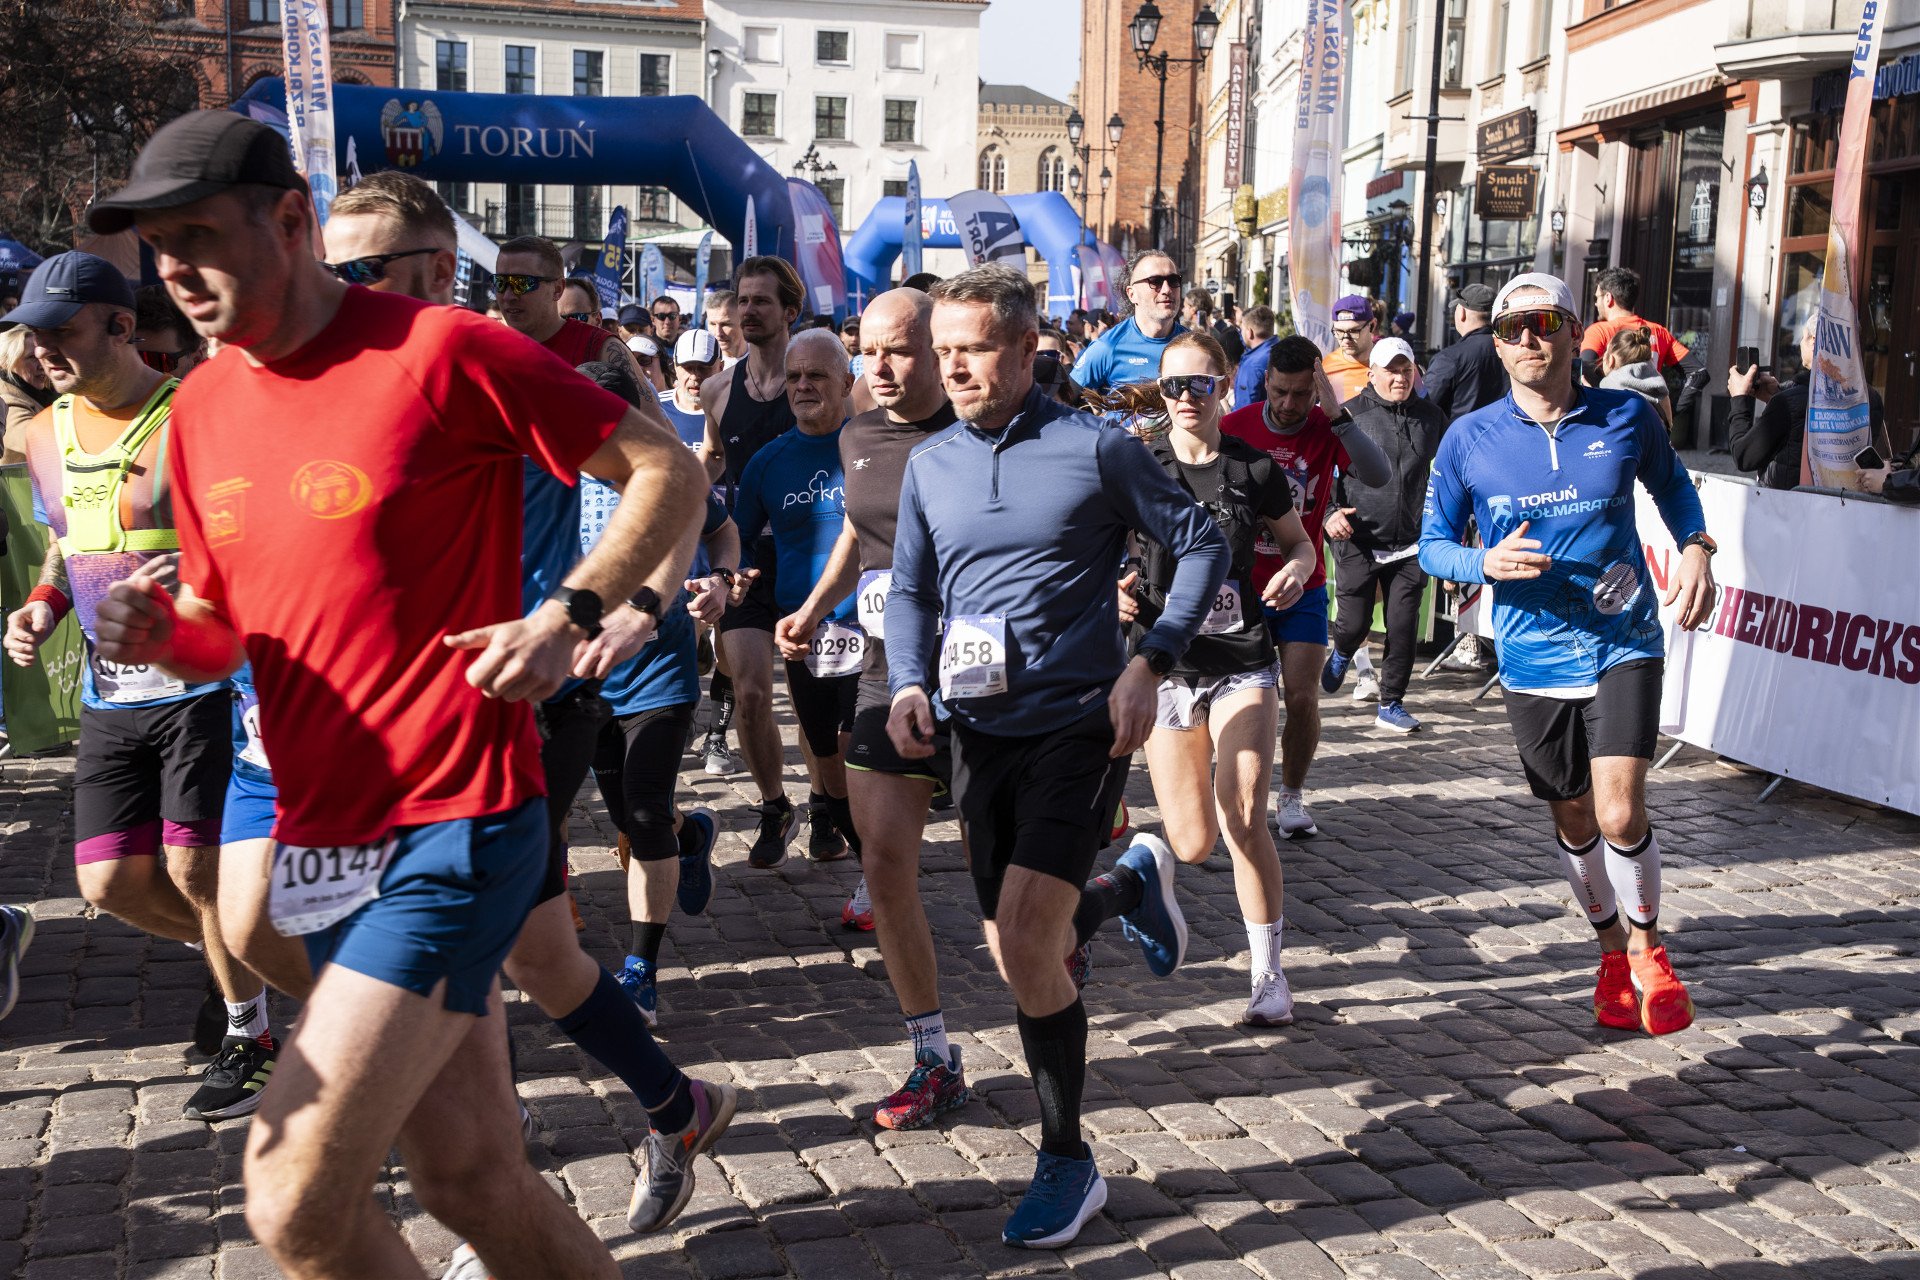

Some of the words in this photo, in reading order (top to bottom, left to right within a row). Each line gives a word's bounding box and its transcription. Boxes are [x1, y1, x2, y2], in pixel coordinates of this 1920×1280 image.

[1228, 64, 1242, 167] APARTAMENTY
[454, 120, 597, 159] TORUŃ
[1487, 172, 1528, 185] Smaki
[1491, 186, 1522, 198] Indii
[1751, 192, 1764, 202] 26
[1517, 484, 1578, 509] TORUŃ
[1518, 494, 1629, 522] PÓŁMARATON
[808, 636, 861, 656] 10298
[1715, 585, 1920, 684] HENDRICKS
